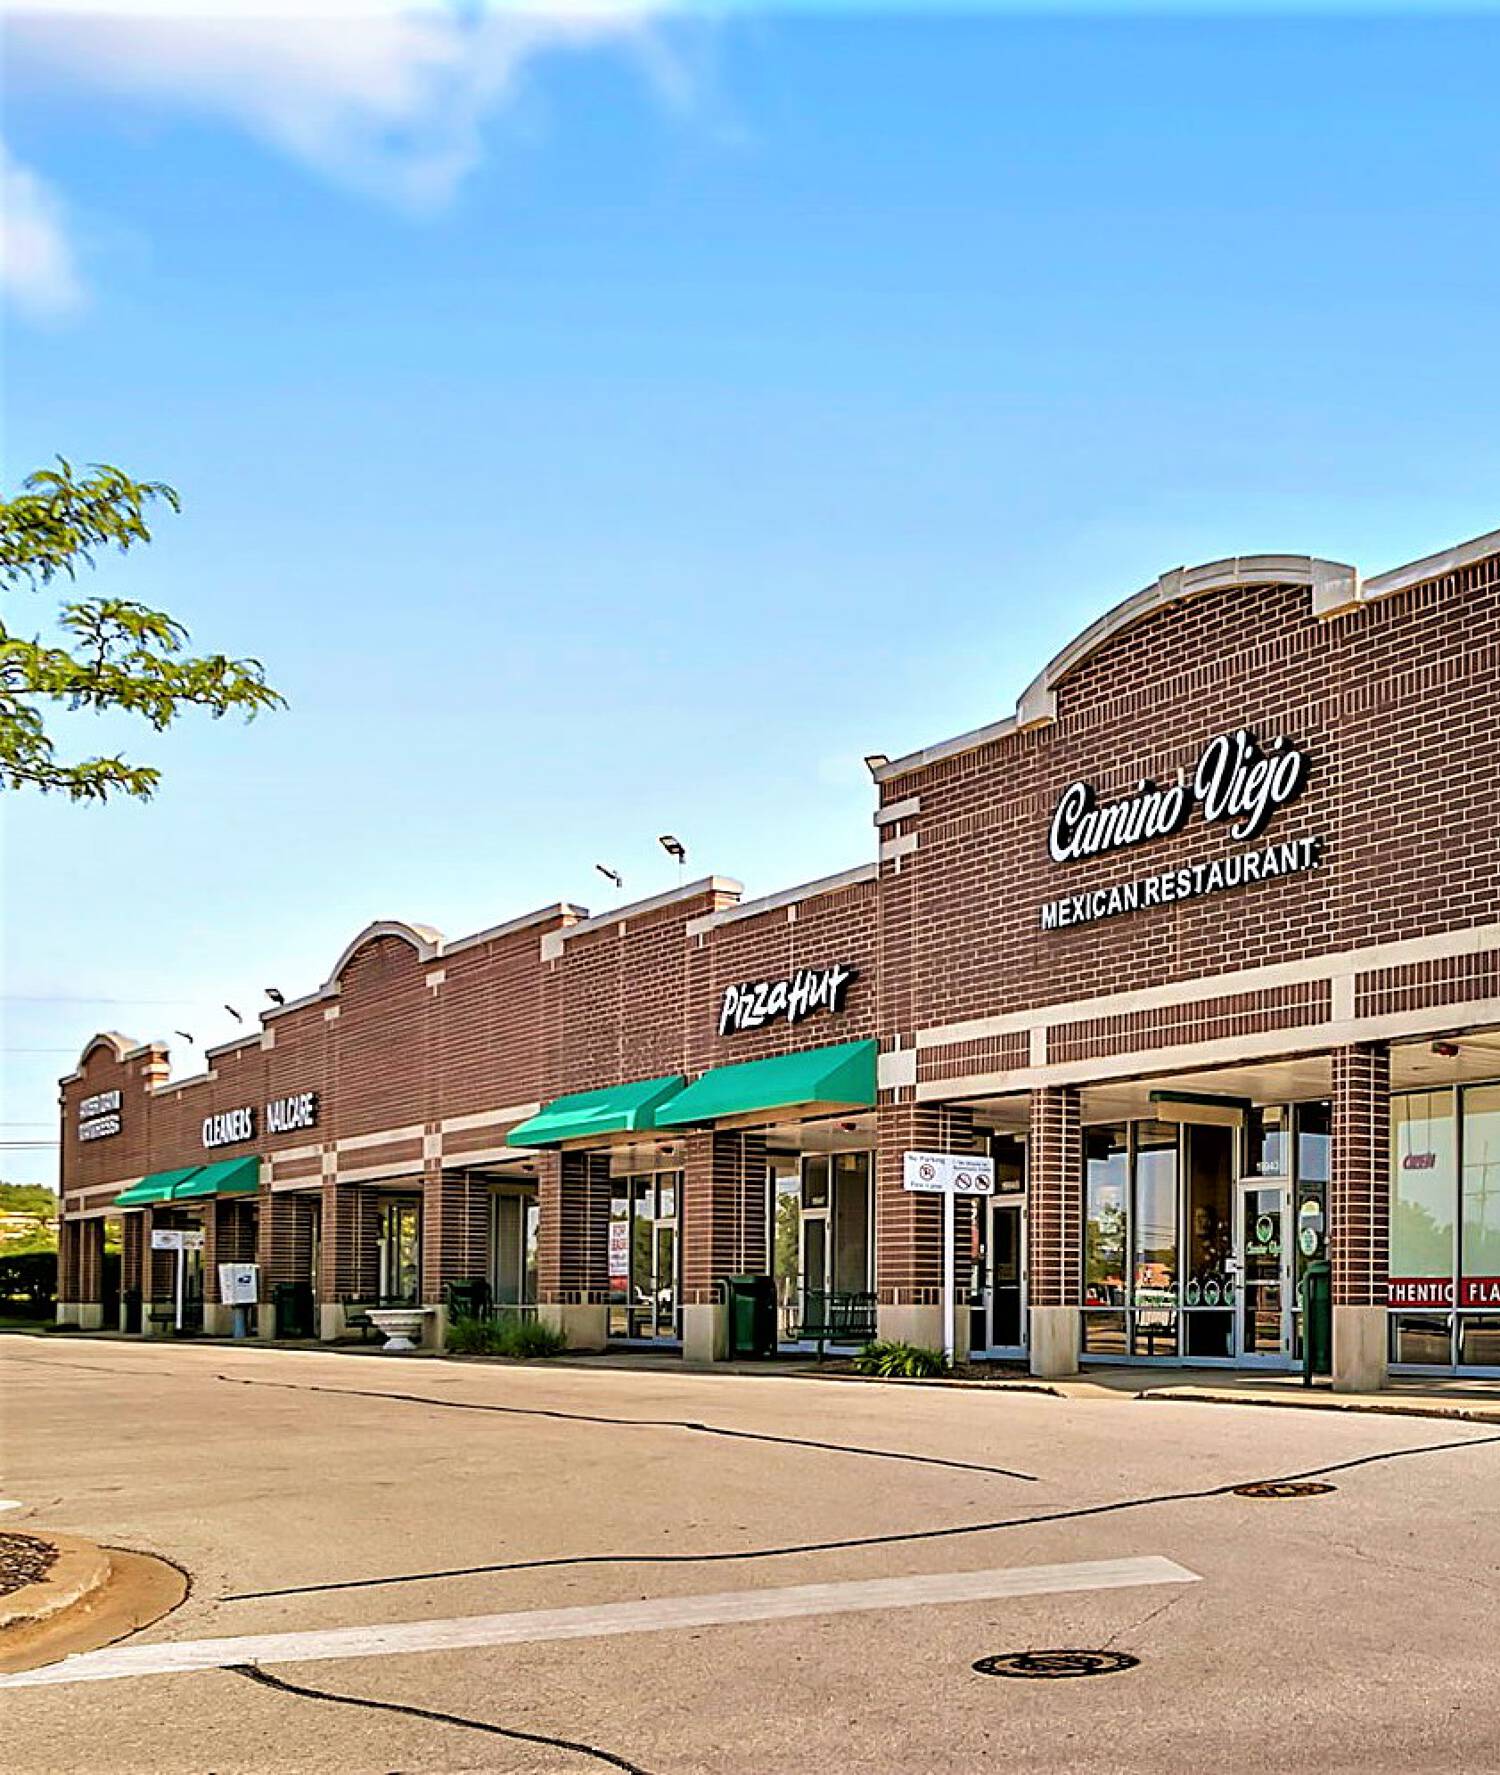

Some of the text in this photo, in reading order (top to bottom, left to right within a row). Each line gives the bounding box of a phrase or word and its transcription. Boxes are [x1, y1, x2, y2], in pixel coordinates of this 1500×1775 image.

[1050, 730, 1301, 862] Camino Viejo
[1041, 838, 1316, 930] MEXICAN RESTAURANT
[719, 964, 849, 1036] Pizza Hut
[203, 1106, 252, 1149] CLEANERS
